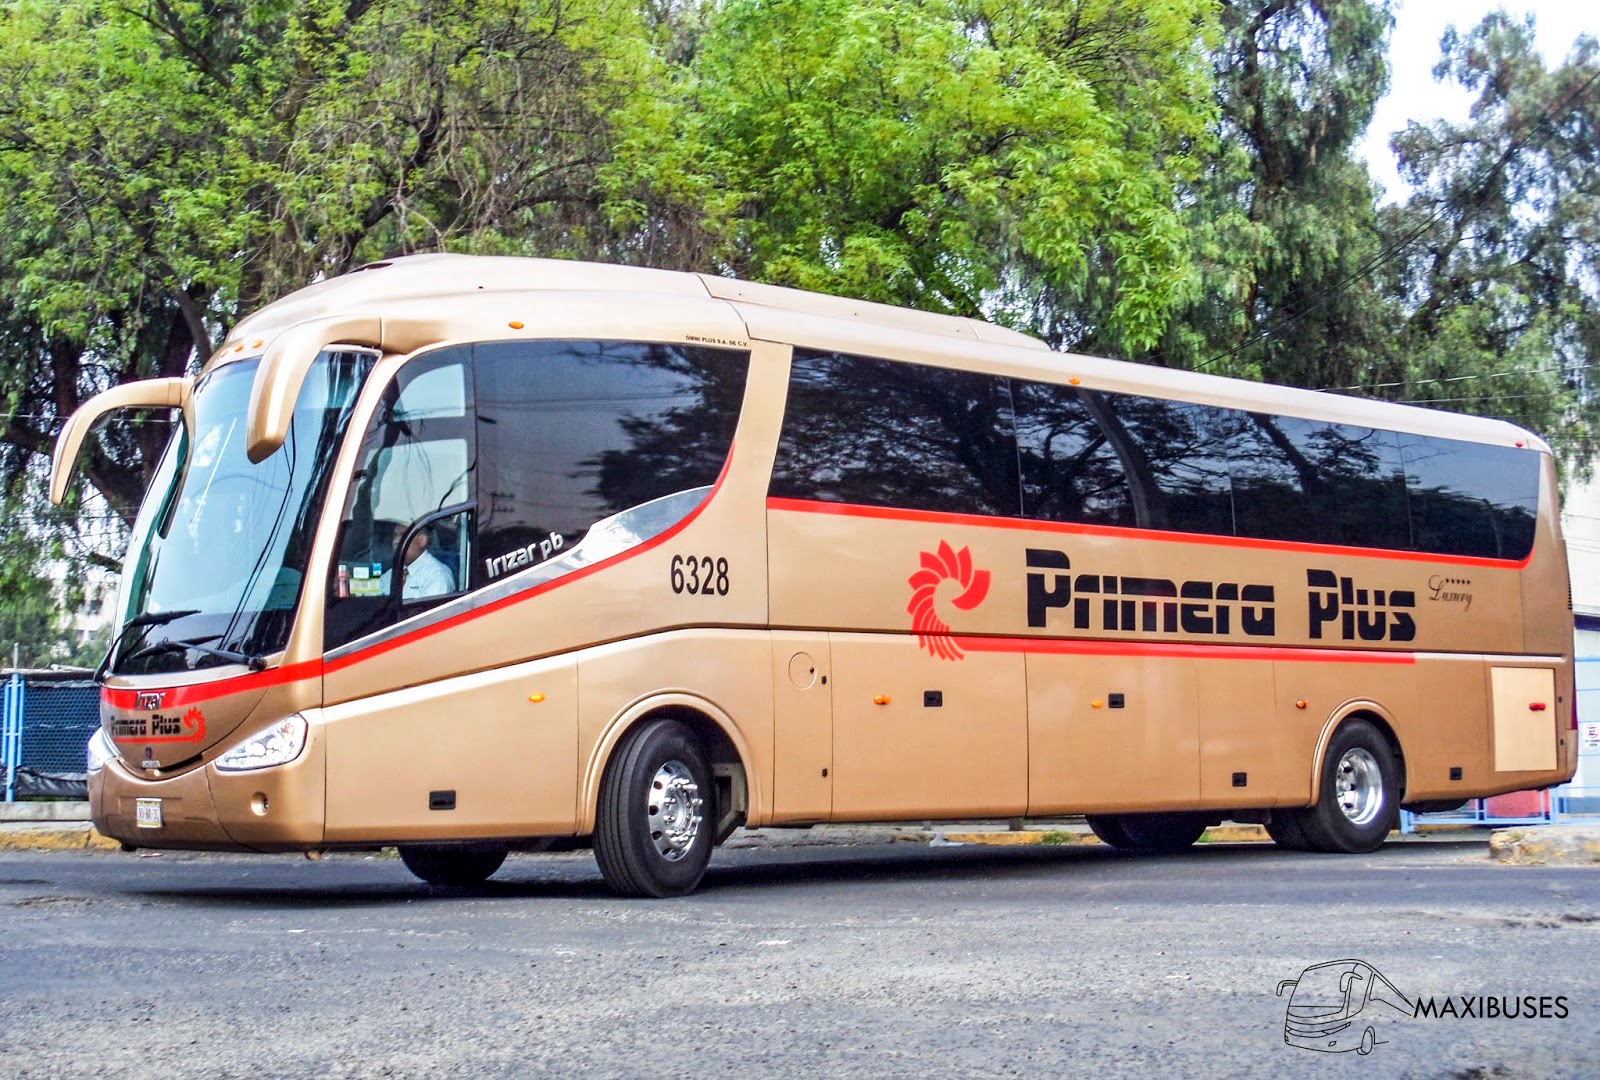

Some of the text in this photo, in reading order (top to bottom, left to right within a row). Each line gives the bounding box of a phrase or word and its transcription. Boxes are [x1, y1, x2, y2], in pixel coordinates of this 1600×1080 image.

[702, 336, 716, 344] PLUS
[485, 531, 563, 578] Irizar pb
[670, 554, 730, 596] 6328
[1428, 575, 1472, 611] Luxury
[1025, 548, 1416, 642] Primera Plus
[110, 714, 181, 736] Primera Plus
